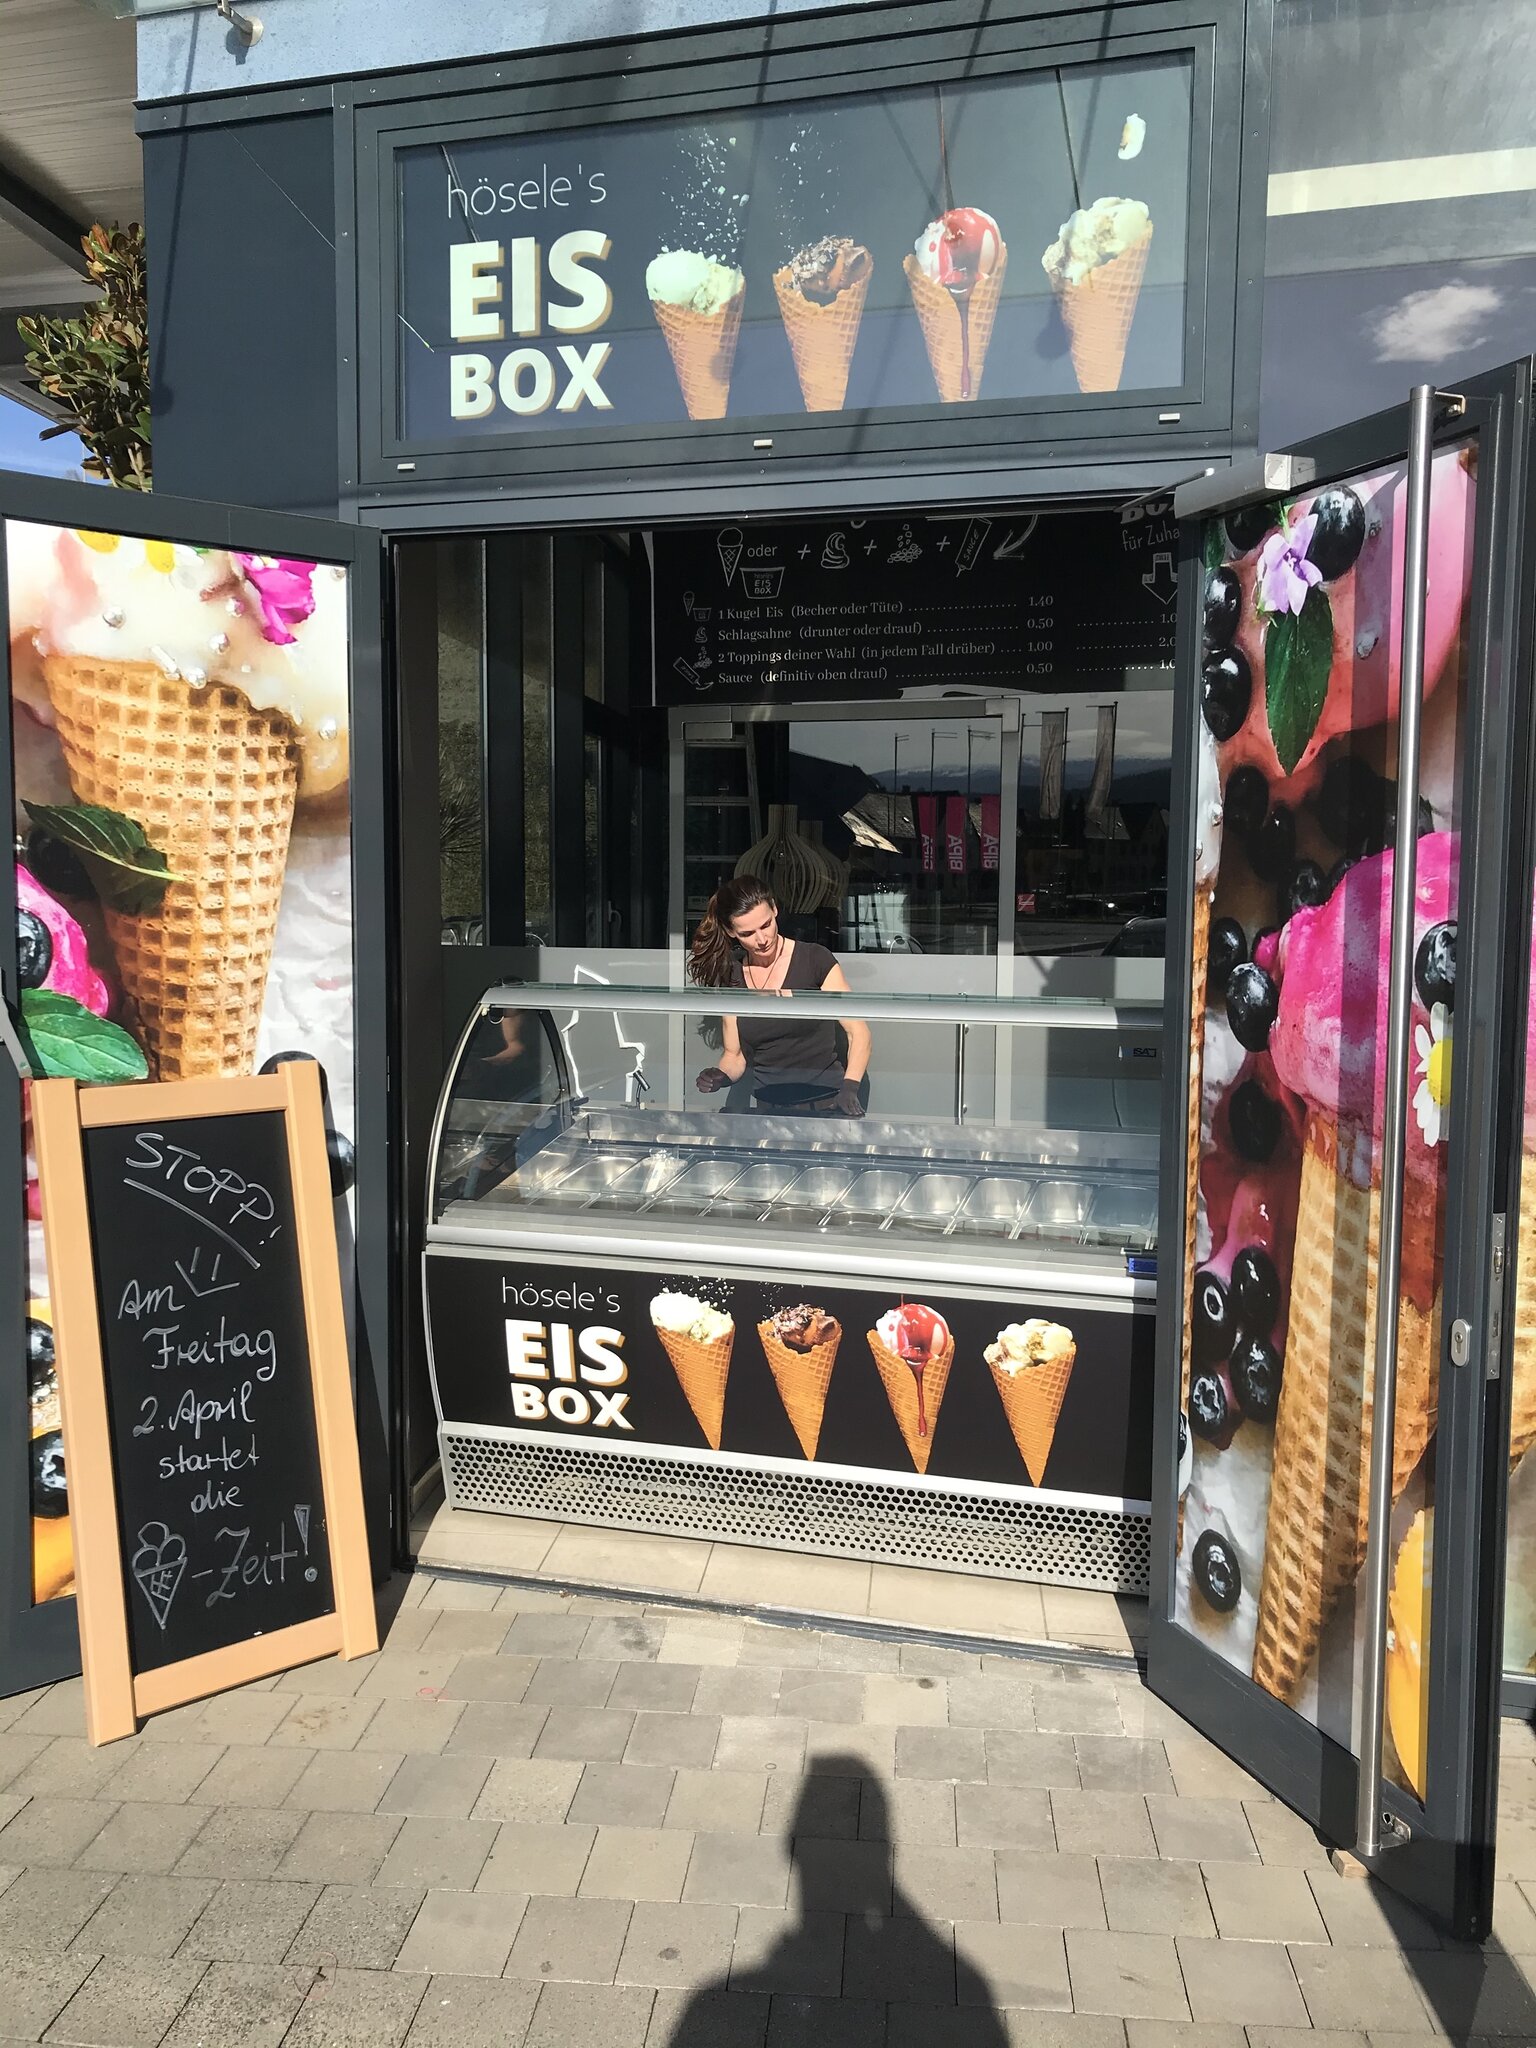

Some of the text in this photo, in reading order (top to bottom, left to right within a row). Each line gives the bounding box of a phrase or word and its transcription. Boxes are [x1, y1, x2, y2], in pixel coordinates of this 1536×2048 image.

[447, 163, 607, 218] hösele's
[450, 230, 612, 342] EIS
[450, 342, 614, 419] BOX
[747, 544, 778, 558] oder
[964, 529, 980, 561] SAUCE
[1122, 520, 1181, 551] für Zuha
[754, 579, 772, 587] EIS
[719, 609, 724, 620] 1
[727, 606, 760, 621] Kugel
[766, 606, 784, 619] Eis
[791, 603, 838, 618] (Becher
[840, 602, 868, 615] oder
[870, 601, 903, 614] Tüte)
[1028, 595, 1054, 607] 1.40
[1160, 613, 1177, 624] 1.0
[718, 618, 1054, 642] Schlagsahne (drunter oder drauf) 0.50
[718, 641, 1053, 665] 2 Toppings deiner Wahl (in jedem Fall drüber) 1.00
[718, 662, 1053, 685] Sauce (definitiv oben drauf) 0.50
[124, 1132, 282, 1246] STOPP!
[118, 1279, 185, 1320] Am
[502, 1276, 621, 1313] hösele's
[142, 1316, 276, 1382] Freitag
[505, 1318, 628, 1387] EIS
[133, 1383, 256, 1437] 2. April
[510, 1382, 635, 1431] BOX
[159, 1434, 260, 1480] startet
[191, 1480, 244, 1513] die
